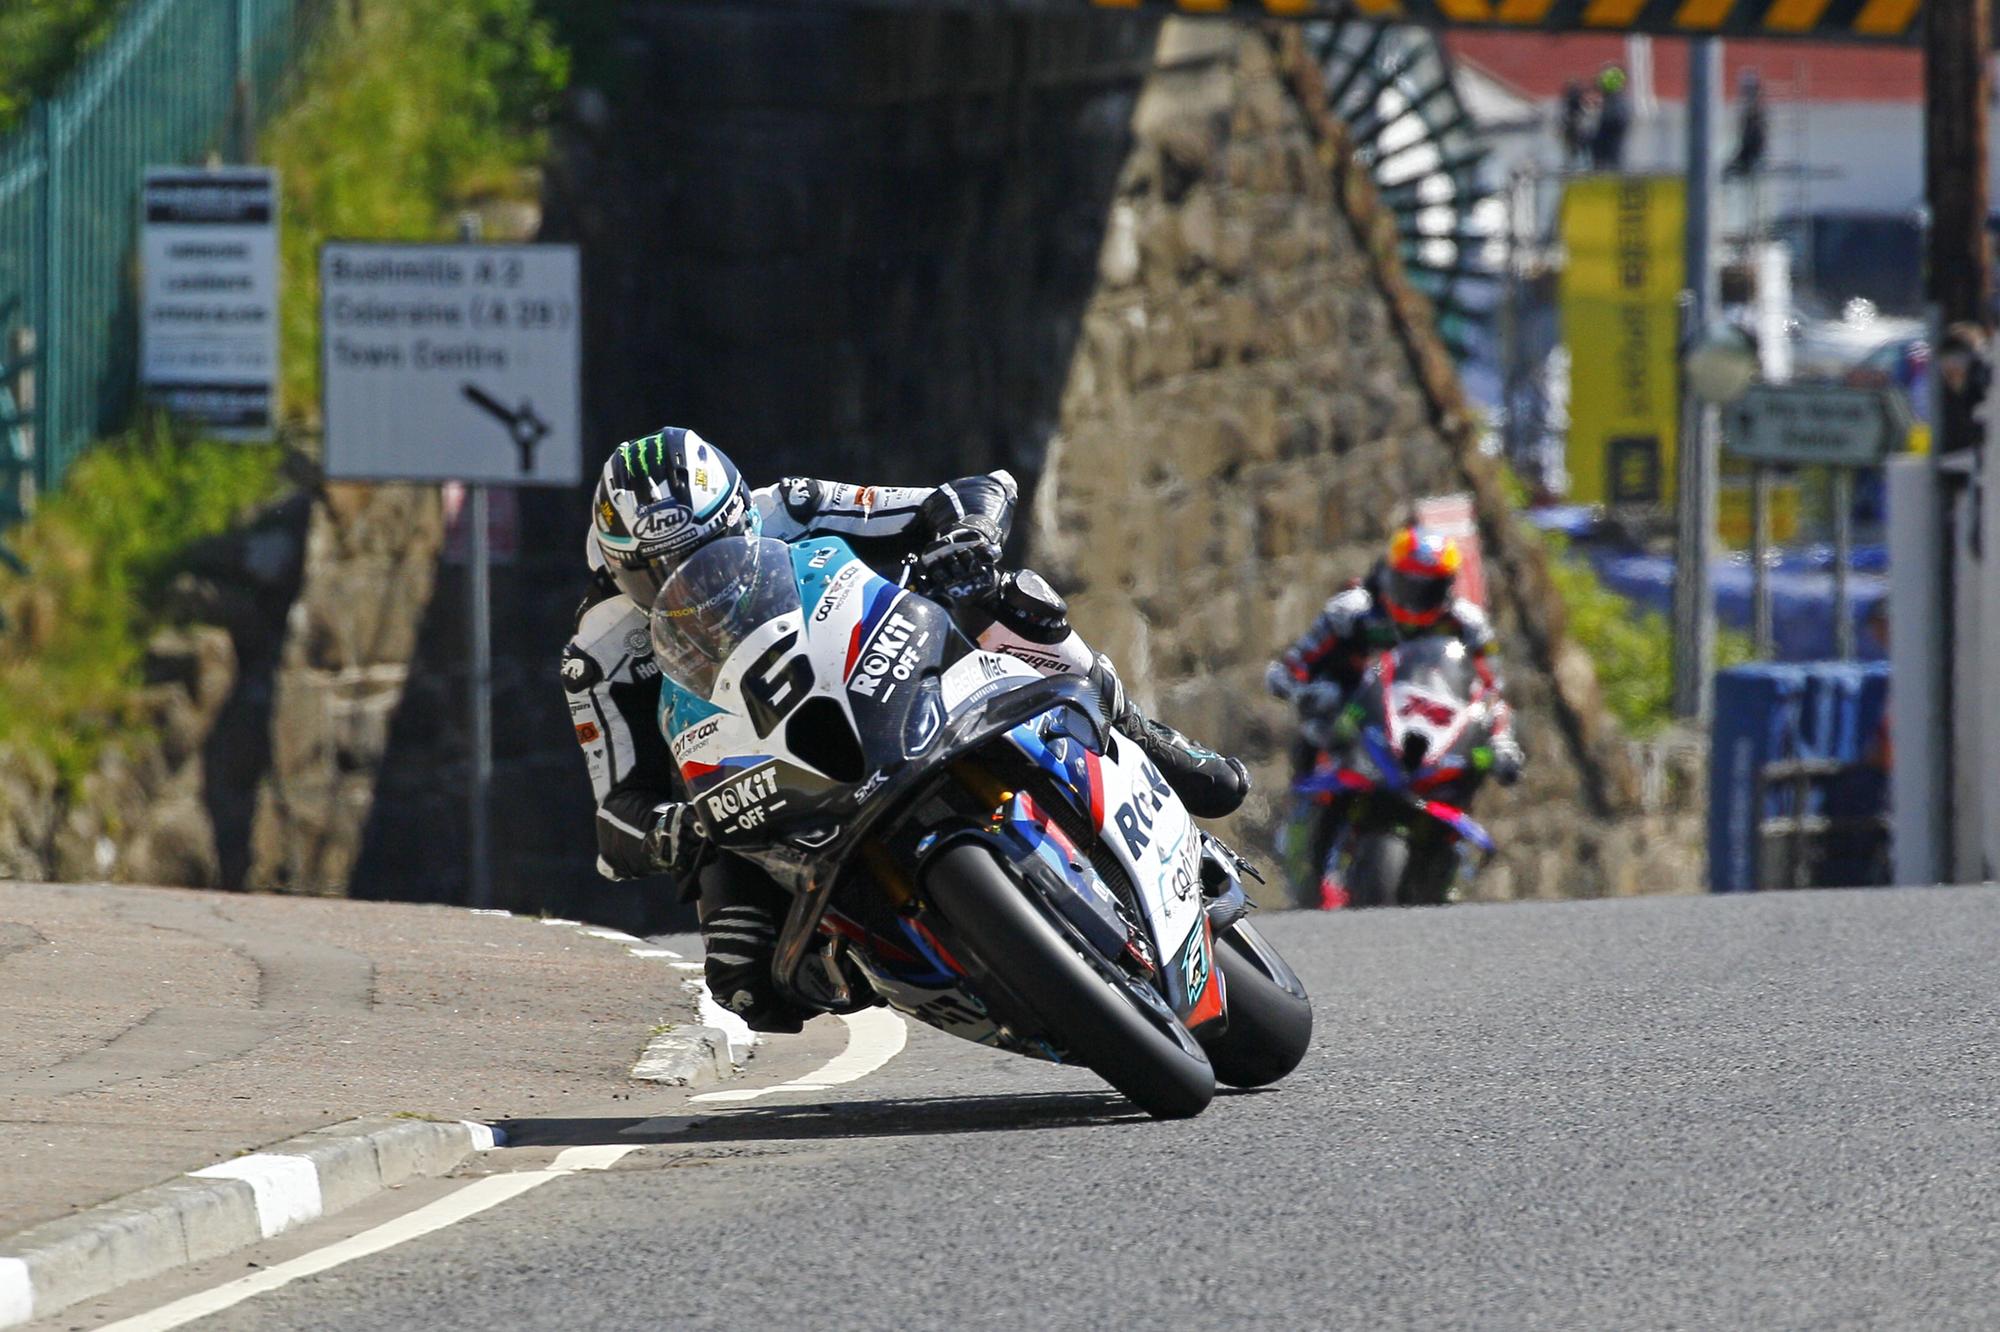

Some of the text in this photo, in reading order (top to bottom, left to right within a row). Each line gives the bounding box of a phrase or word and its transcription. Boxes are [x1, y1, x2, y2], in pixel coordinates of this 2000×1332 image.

[333, 338, 404, 368] Town
[638, 508, 685, 537] Arai
[815, 596, 839, 622] carl
[893, 646, 920, 681] OFF
[740, 629, 816, 740] 6
[698, 719, 720, 740] cox
[738, 807, 766, 831] OFF
